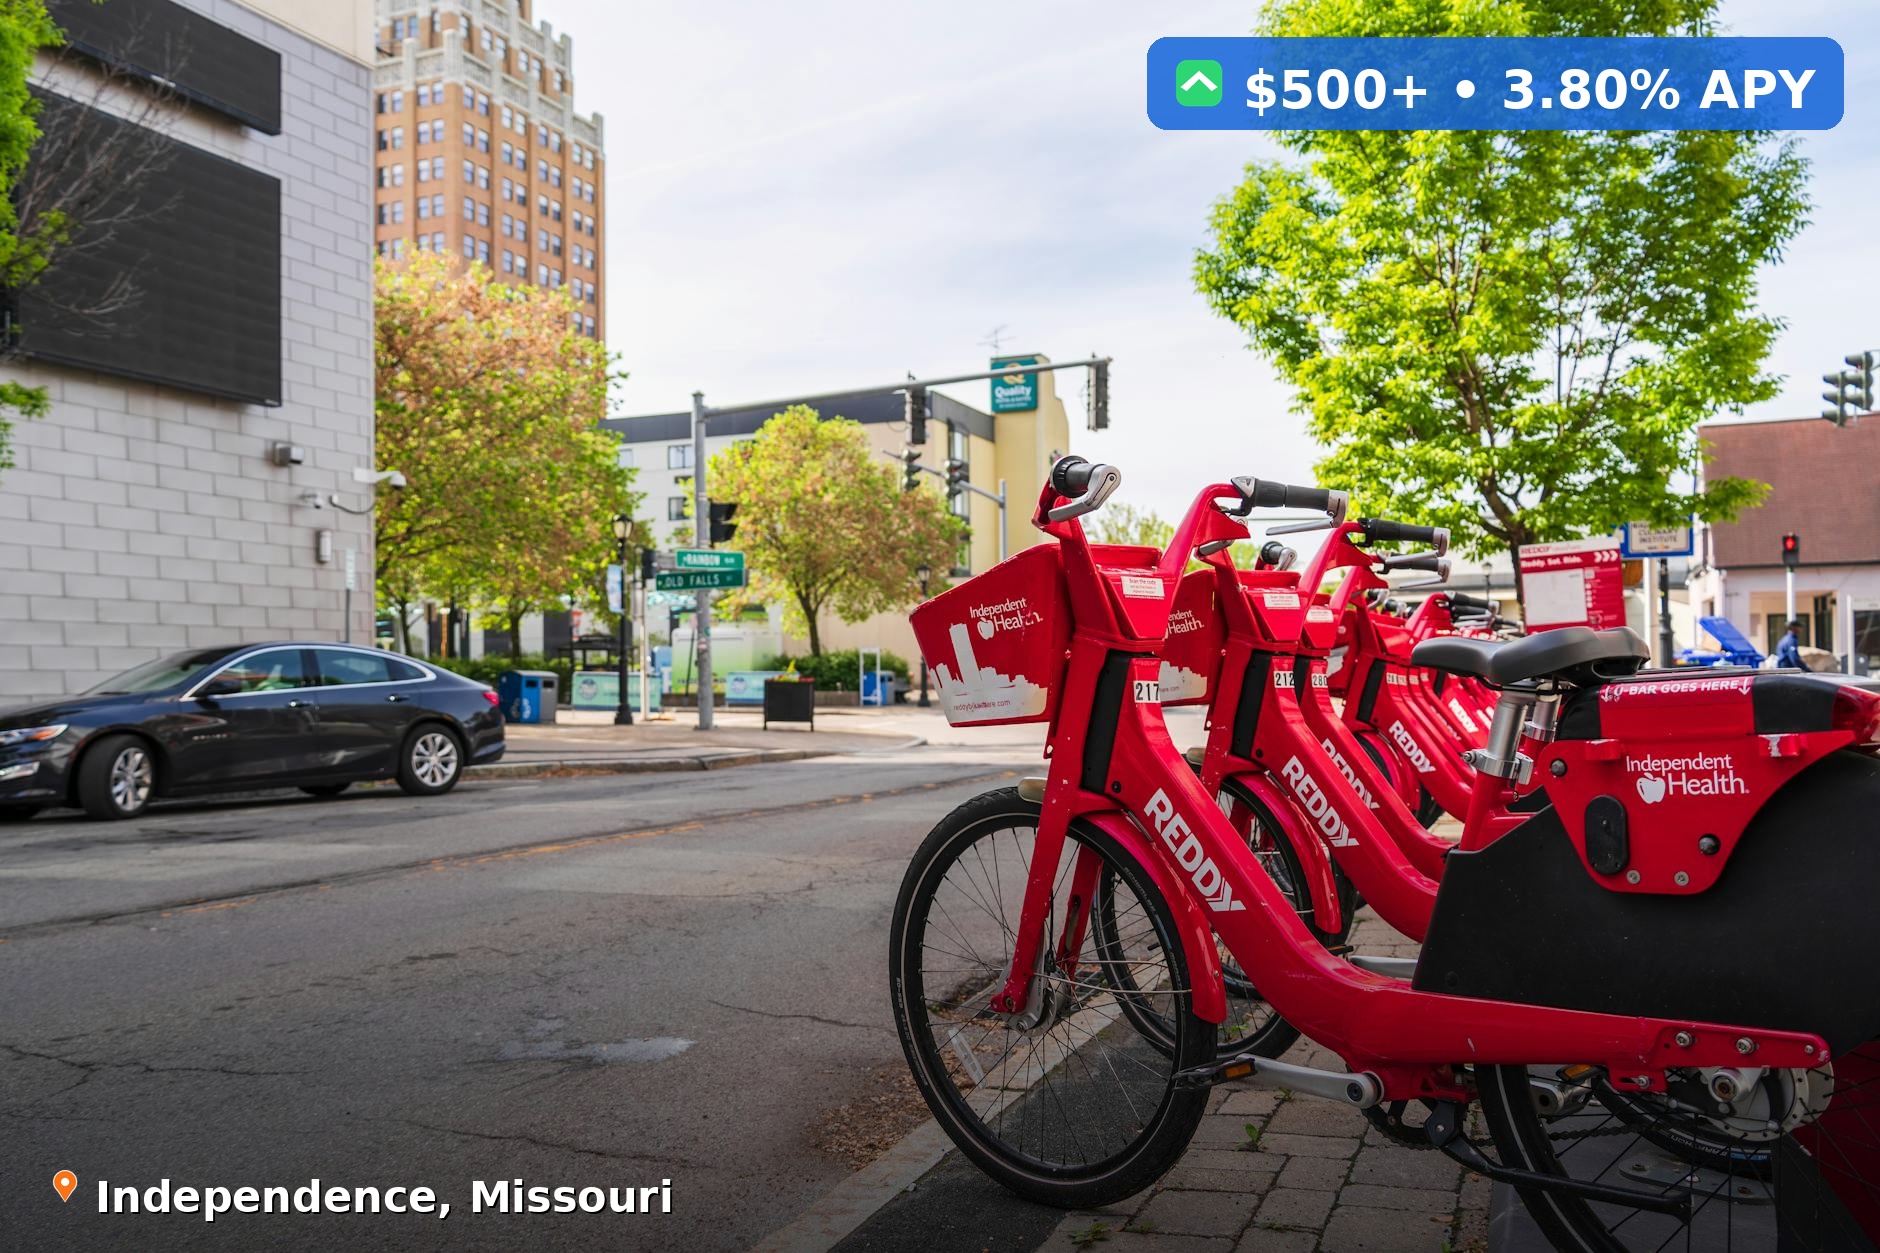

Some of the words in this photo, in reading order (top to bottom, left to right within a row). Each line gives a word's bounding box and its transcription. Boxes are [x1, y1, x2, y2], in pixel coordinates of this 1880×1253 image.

[995, 385, 1032, 398] Quality
[664, 576, 684, 587] OLD
[689, 574, 720, 585] FALLS
[969, 597, 1027, 619] Independent
[1275, 672, 1295, 687] 212
[1660, 683, 1698, 694] GOES
[1701, 680, 1739, 691] HERE
[1135, 682, 1160, 702] 217
[1389, 719, 1437, 773] REDDY
[1626, 751, 1733, 776] Independent
[1282, 755, 1360, 848] REDDY
[1143, 787, 1247, 912] REDDY
